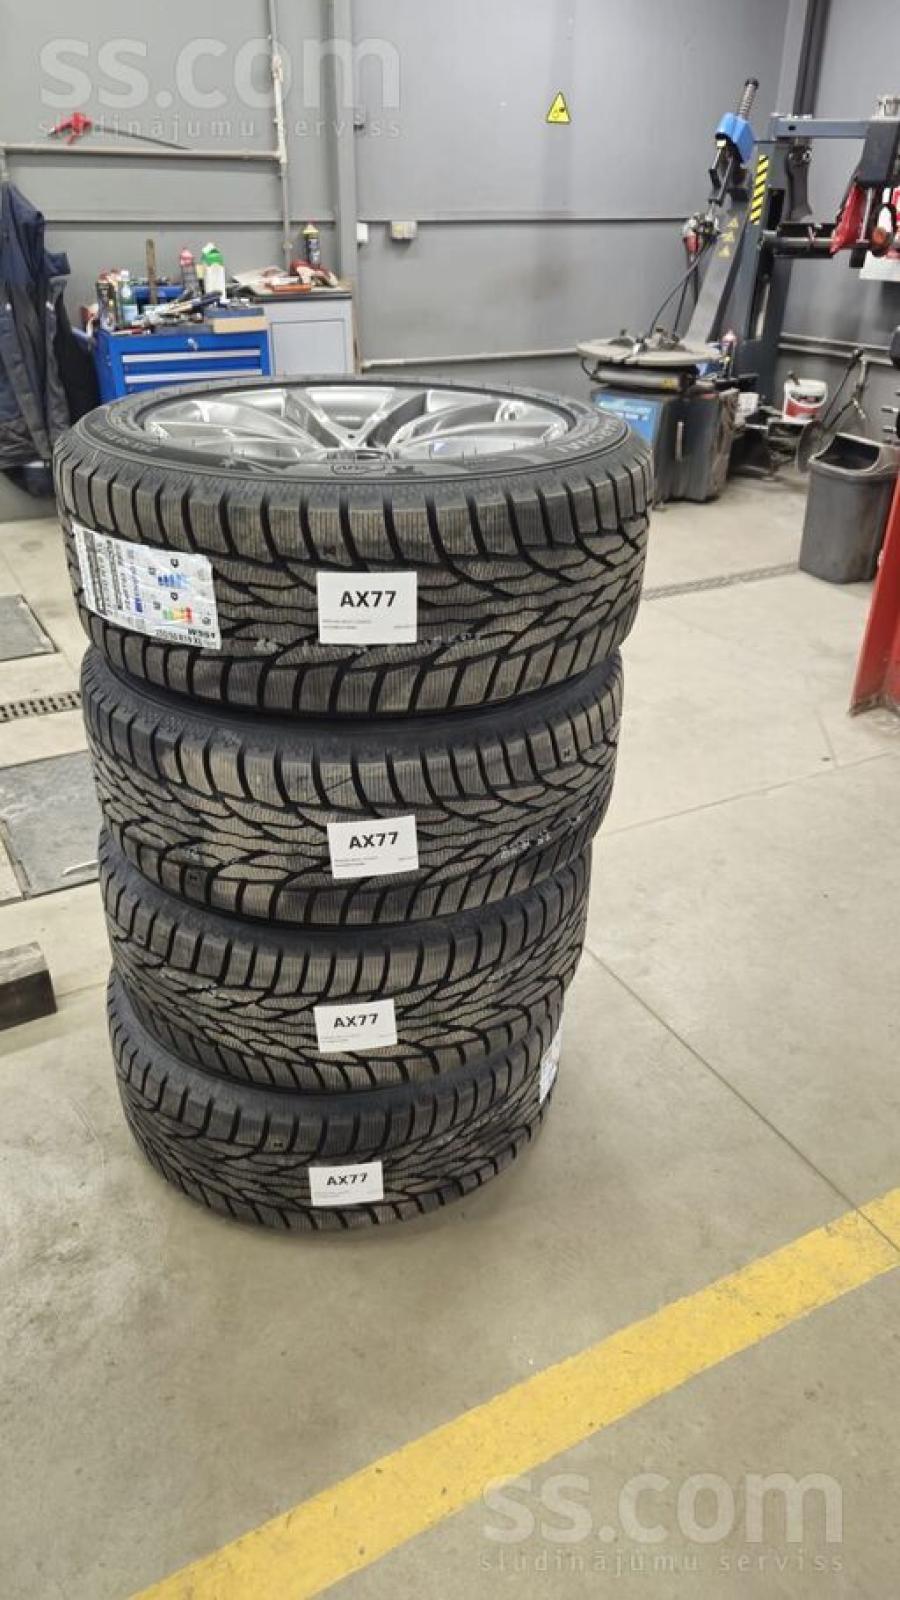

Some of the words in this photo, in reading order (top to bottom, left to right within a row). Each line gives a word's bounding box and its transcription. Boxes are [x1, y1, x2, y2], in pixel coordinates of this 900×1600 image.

[340, 590, 397, 608] AX77
[349, 831, 398, 849] AX77
[333, 1012, 378, 1029] AX77
[326, 1172, 368, 1186] AX77
